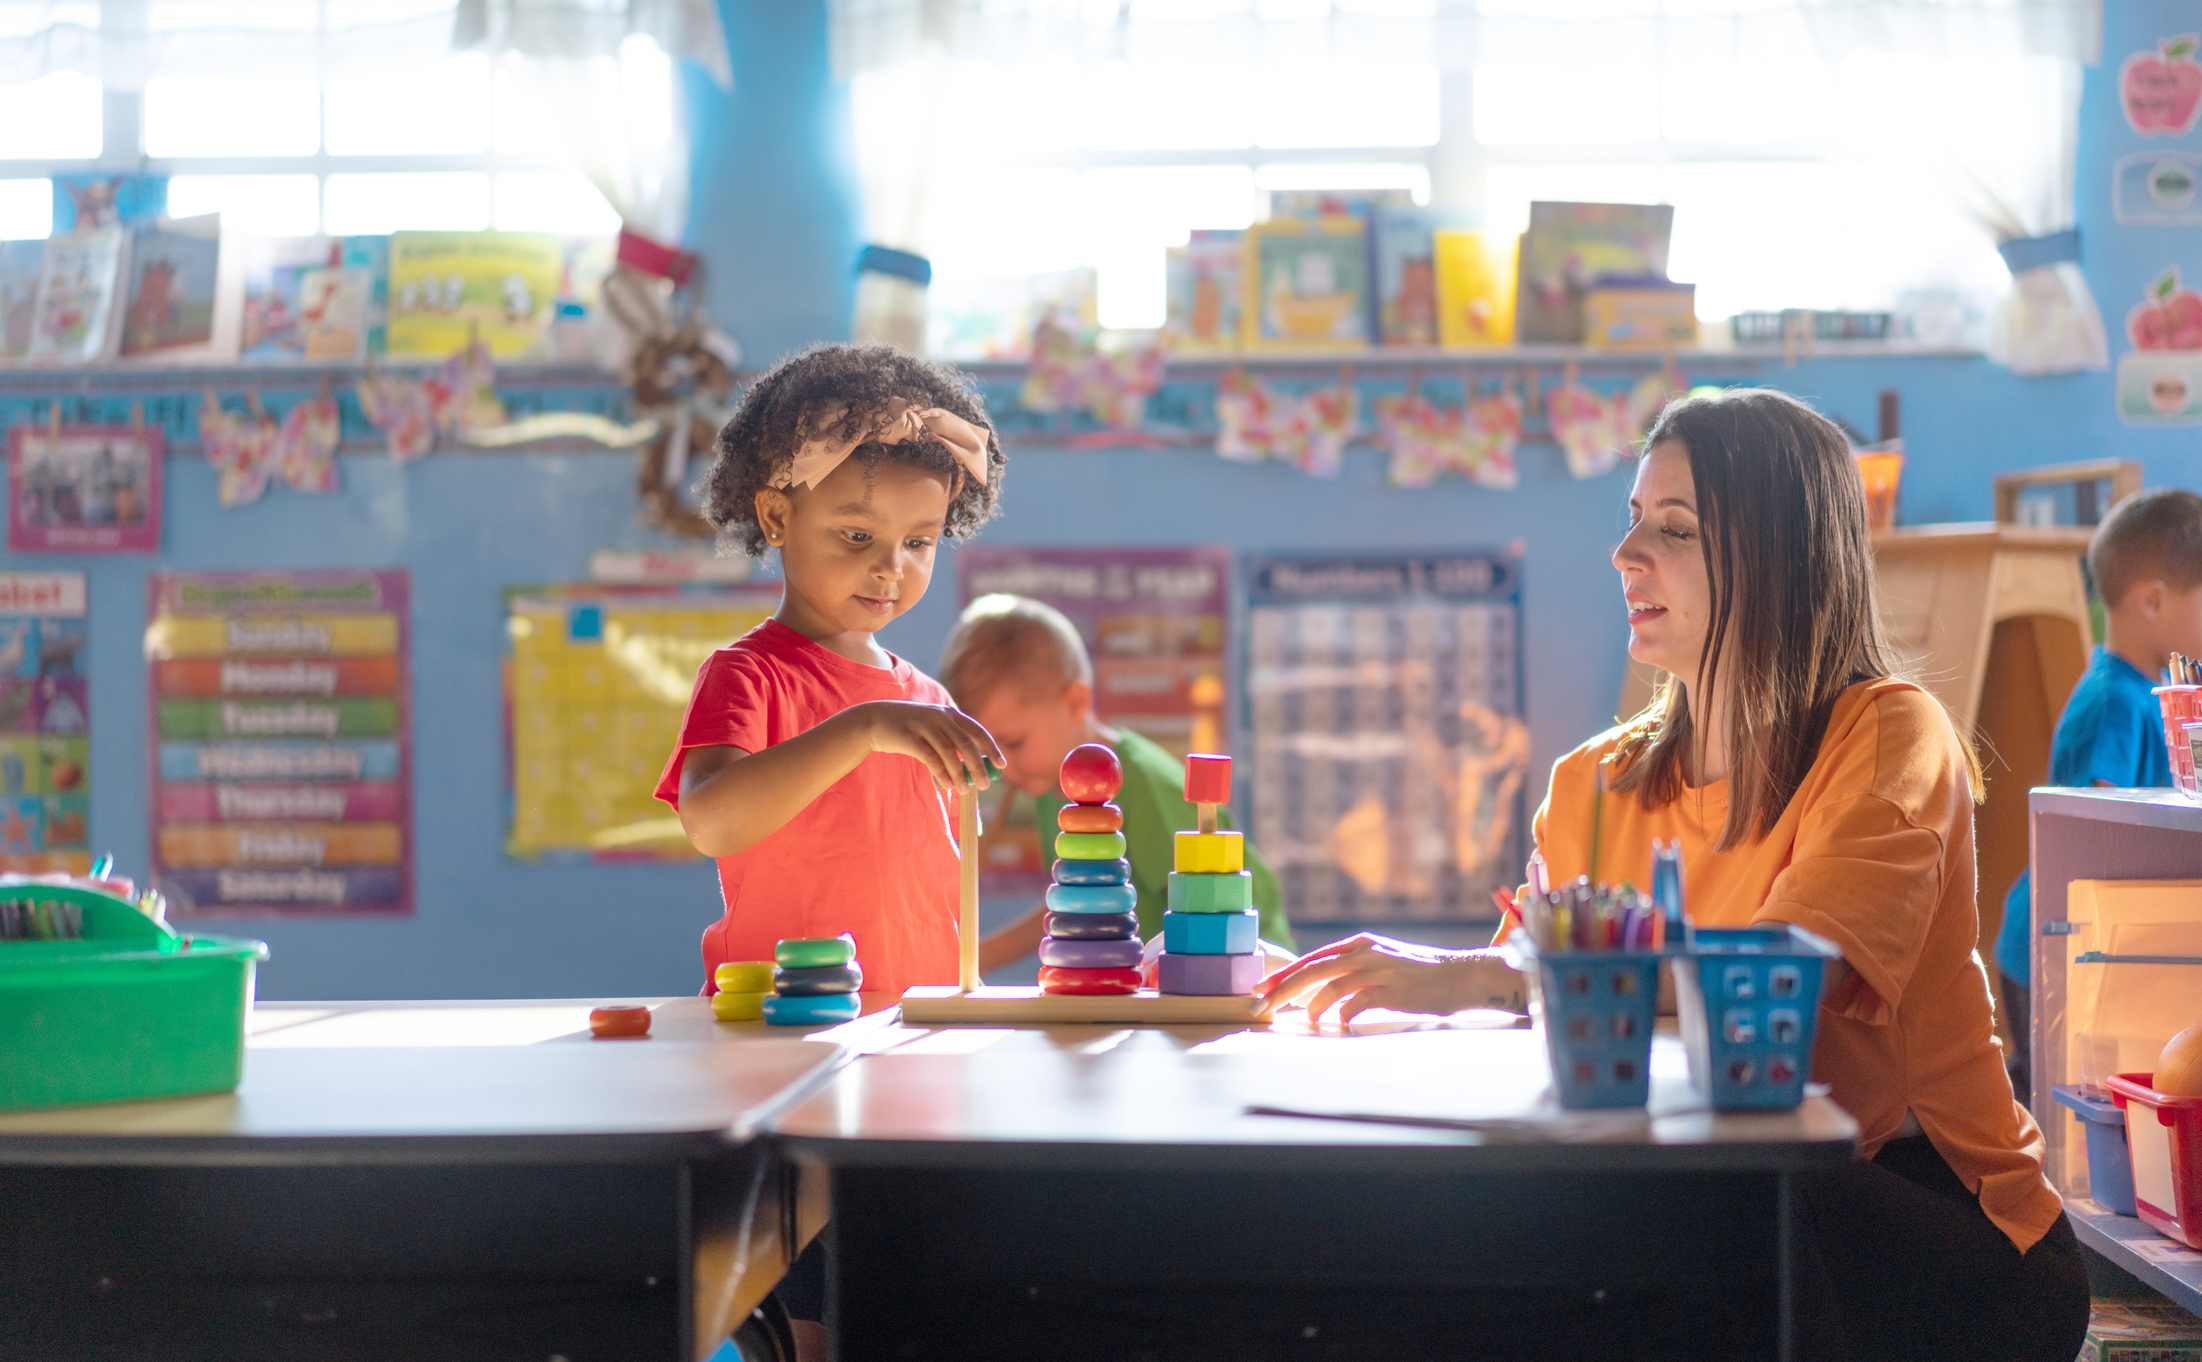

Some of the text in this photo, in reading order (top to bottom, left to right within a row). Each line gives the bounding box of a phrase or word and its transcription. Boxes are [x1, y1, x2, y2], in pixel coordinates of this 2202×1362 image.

[228, 617, 331, 654] Sunday
[221, 660, 338, 698] Monday
[221, 701, 339, 740] Tuesday
[198, 746, 364, 783] Wednesday
[217, 785, 348, 822] Thursday
[238, 828, 327, 867] Friday
[219, 869, 347, 905] Saturday
